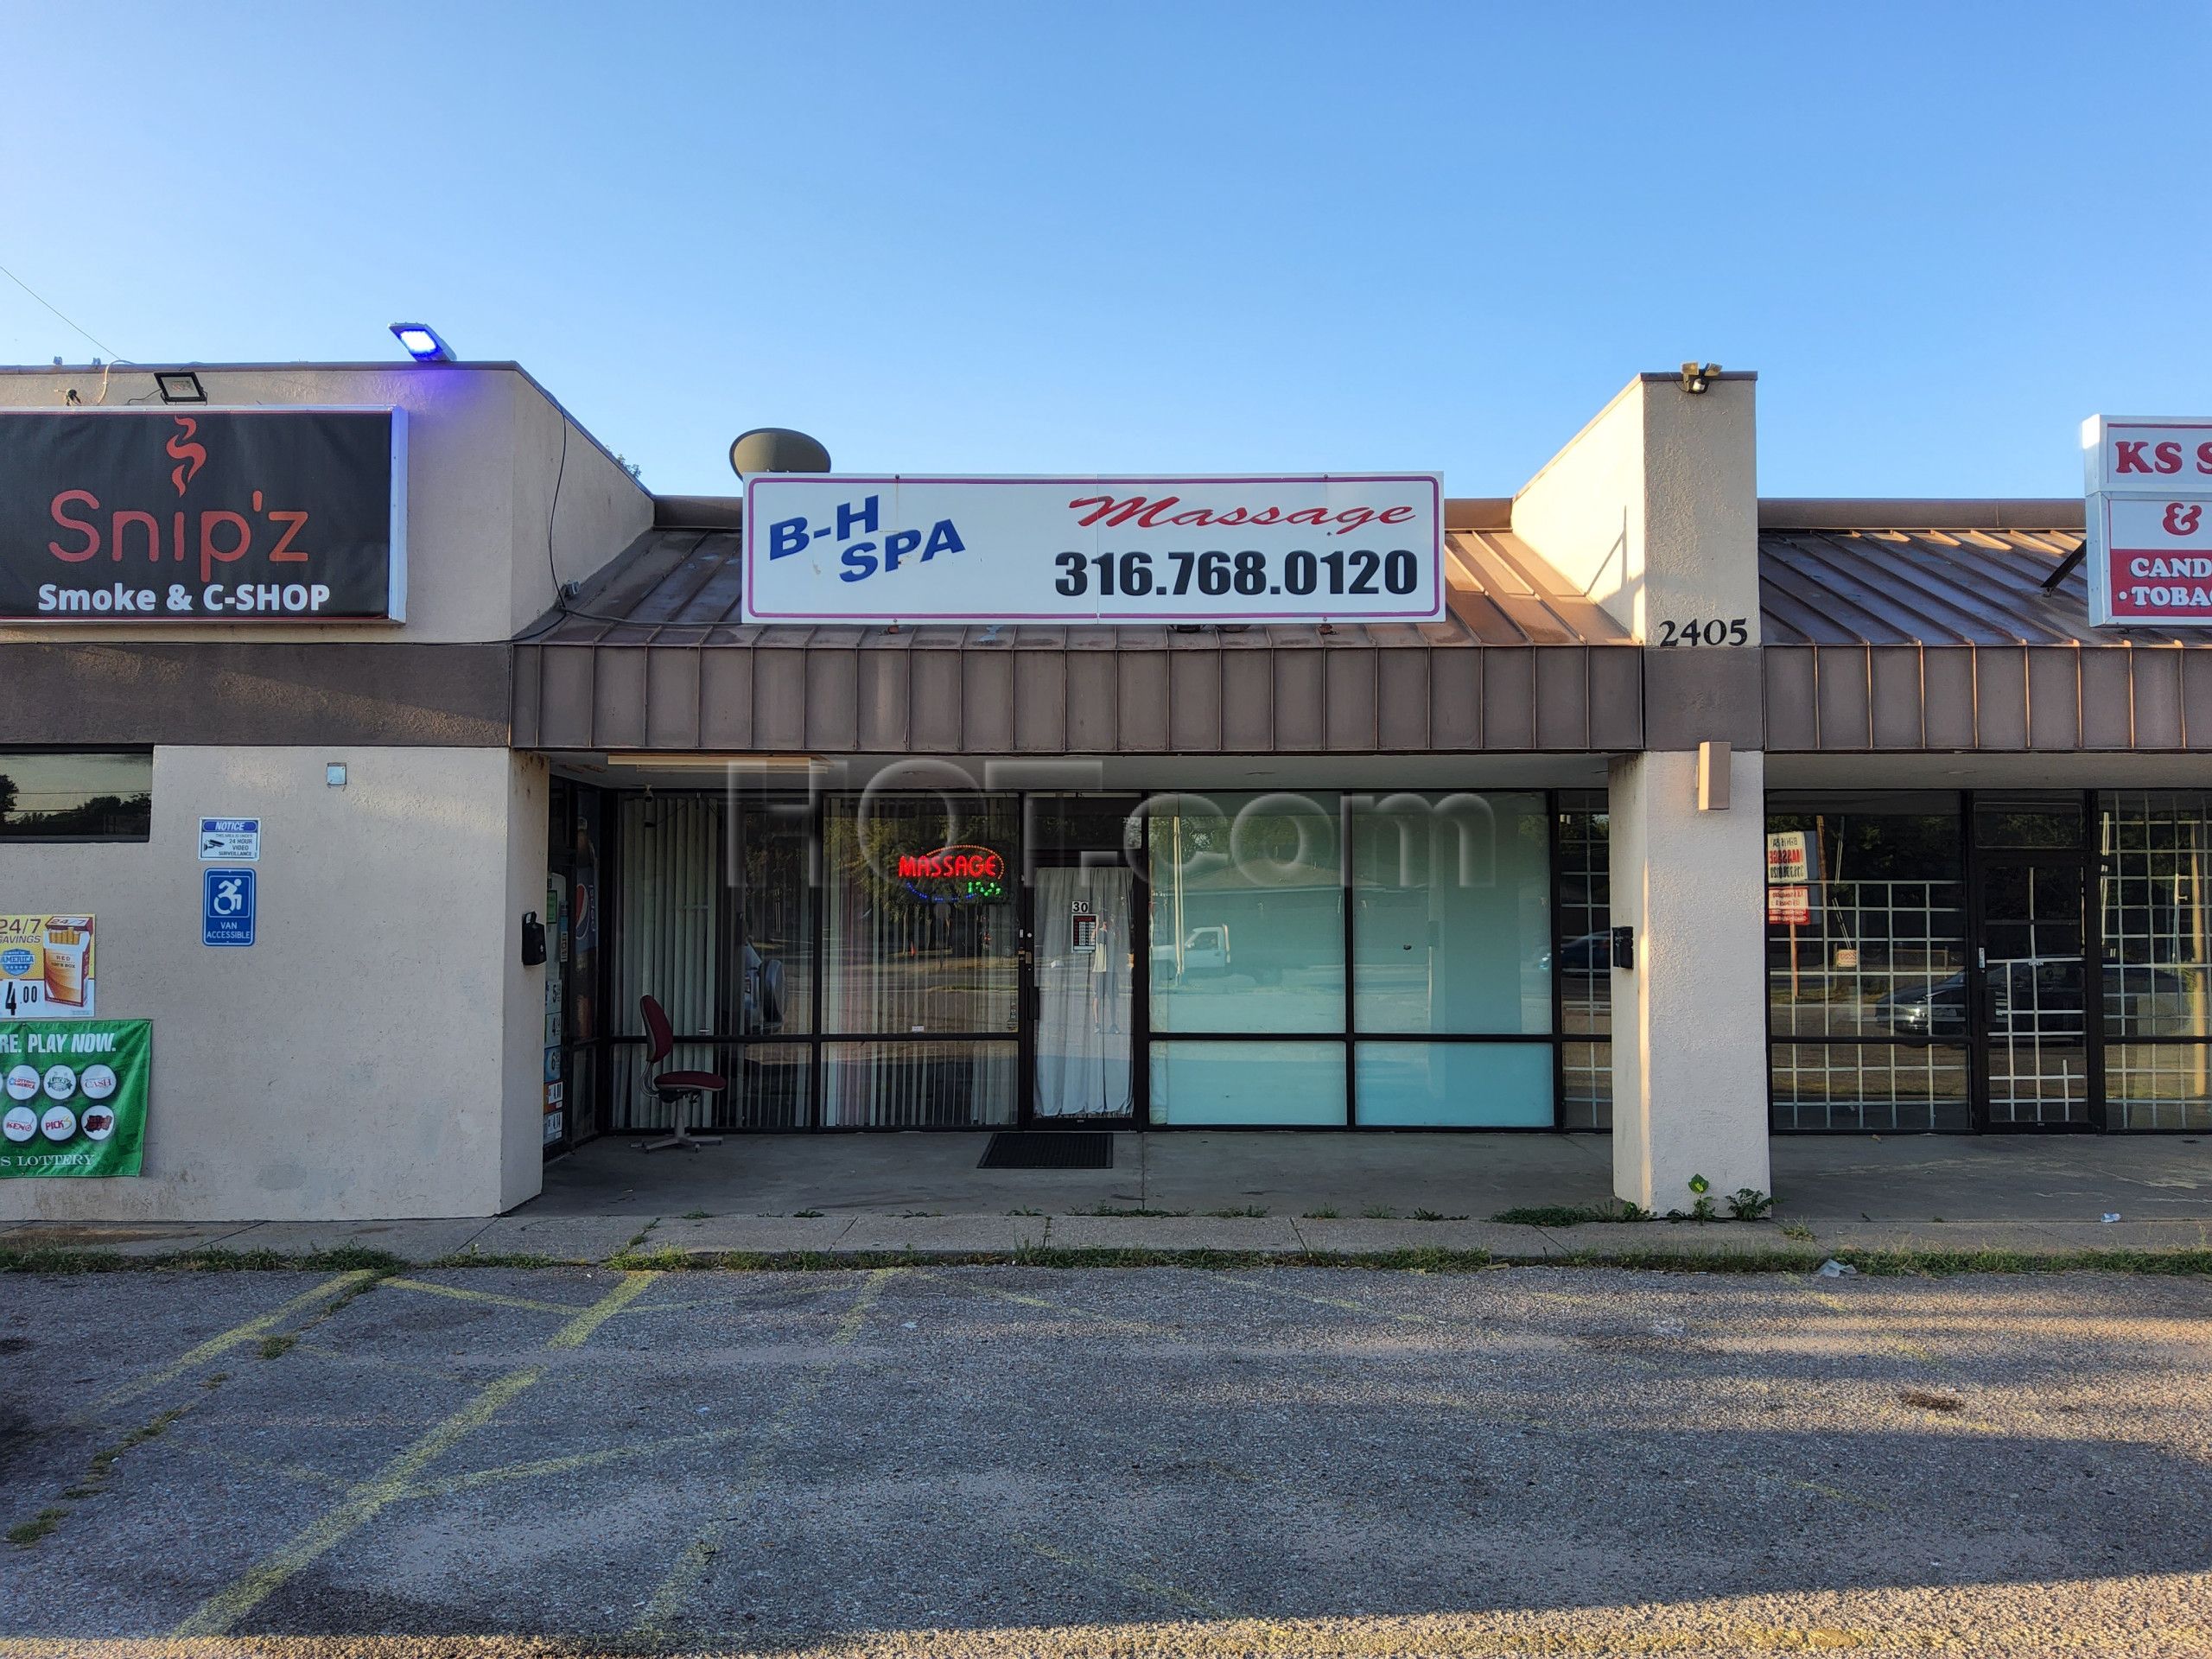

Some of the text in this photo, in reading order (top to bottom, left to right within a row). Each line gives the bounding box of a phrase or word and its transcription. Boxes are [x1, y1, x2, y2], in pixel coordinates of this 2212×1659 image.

[2115, 441, 2183, 474] KS
[1069, 495, 1416, 534] Massage
[2163, 502, 2202, 536] &
[49, 489, 308, 582] Snip'z
[770, 494, 878, 561] B-H
[839, 518, 966, 582] SPA
[1055, 550, 1418, 596] 316.768.0120
[38, 583, 330, 611] Smoke & C-SHOP
[2131, 587, 2212, 606] TOBA
[1659, 618, 1747, 646] 2405
[215, 822, 245, 830] NOTICE
[899, 855, 996, 877] MASSAGE
[1073, 901, 1088, 912] 30
[207, 931, 251, 939] ACCESSIBLE
[28, 1033, 67, 1052] PLAY
[71, 1033, 116, 1052] NOW.
[85, 1078, 111, 1089] CASH
[6, 1121, 32, 1131] KENO
[46, 1120, 64, 1130] PICK
[17, 1154, 94, 1166] LOTTERY
